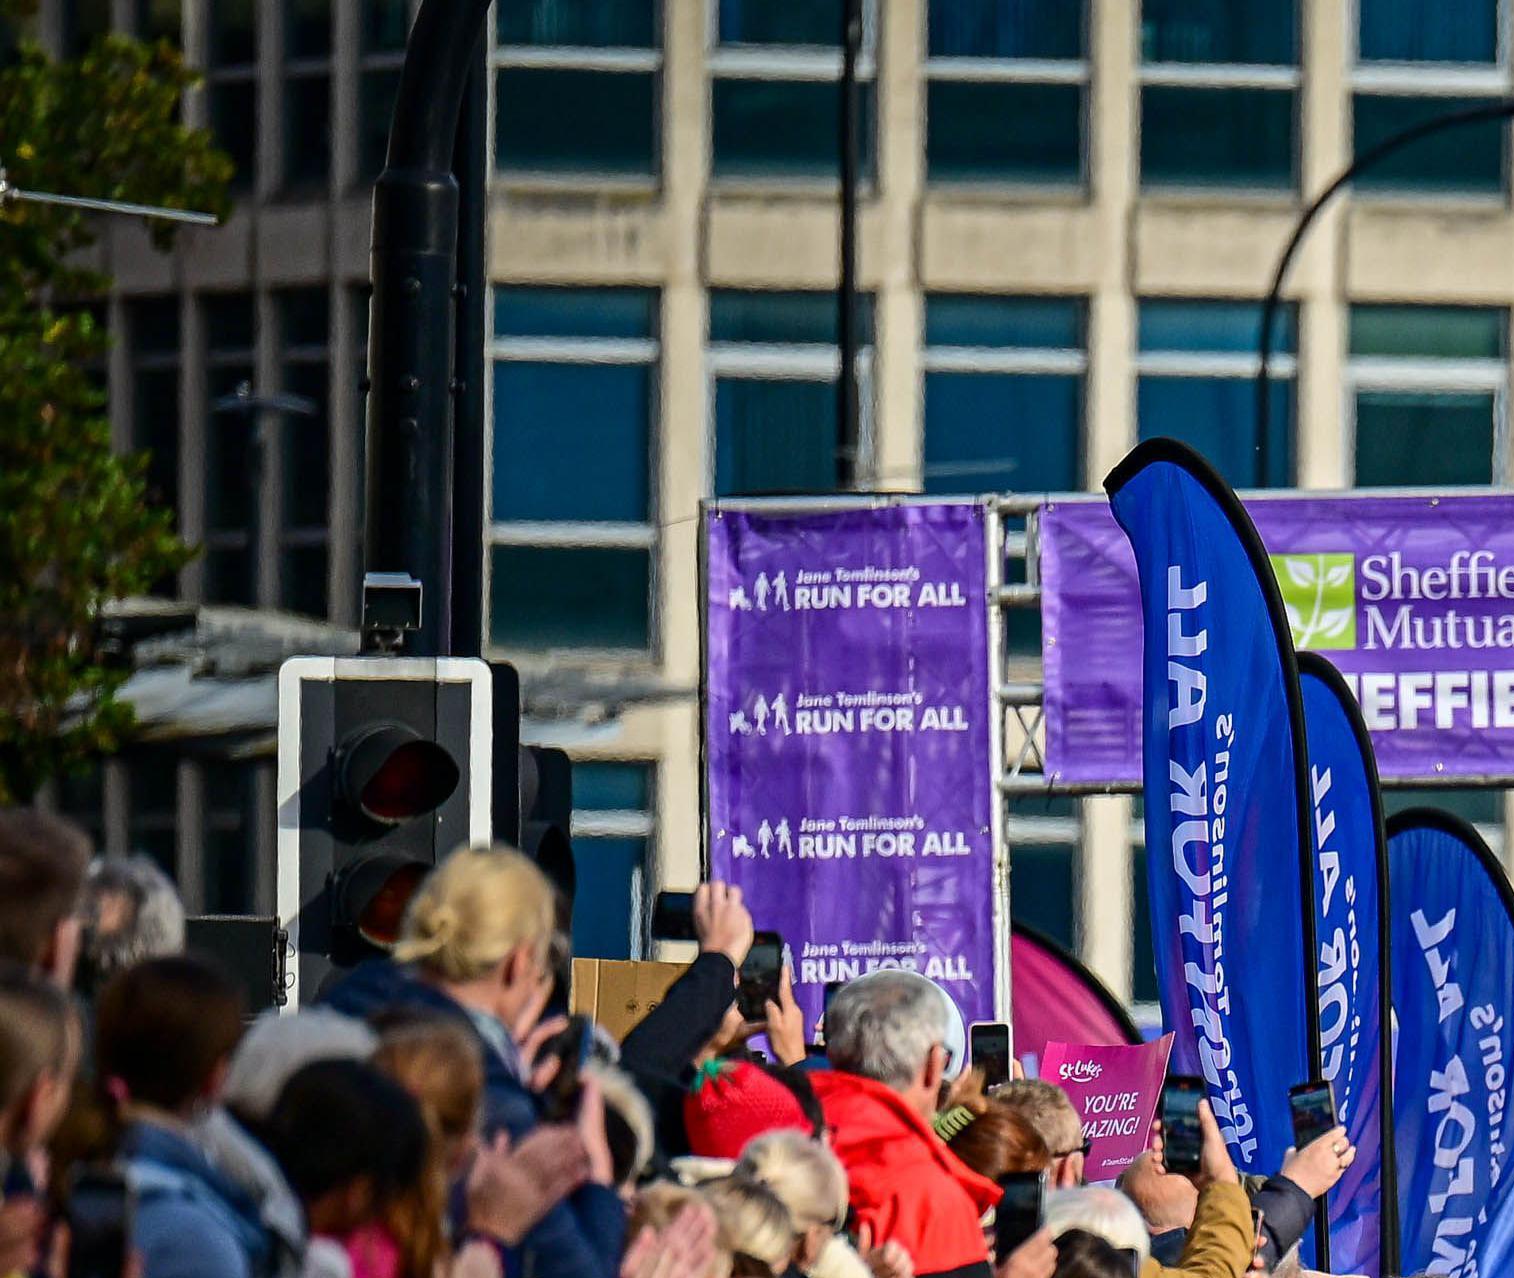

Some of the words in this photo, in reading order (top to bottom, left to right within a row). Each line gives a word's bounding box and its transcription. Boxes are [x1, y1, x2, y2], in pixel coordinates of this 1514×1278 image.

[795, 569, 833, 585] Jane
[835, 565, 921, 583] Tomlinson's
[795, 584, 852, 611] RUN
[857, 583, 911, 609] FOR
[917, 582, 967, 608] ALL
[796, 693, 833, 708] Jane
[836, 690, 923, 708] Tomlinson's
[795, 709, 855, 735] RUN
[860, 708, 914, 733] FOR
[920, 706, 969, 731] ALL
[799, 817, 836, 833] Jane
[838, 814, 925, 831] Tomlinson's
[799, 833, 859, 860] RUN
[862, 832, 916, 858] FOR
[921, 831, 971, 857] ALL
[801, 958, 860, 985] RUN
[925, 955, 973, 981] ALL
[1084, 1092, 1139, 1115] YOU'RE
[1080, 1116, 1141, 1139] MAZING!
